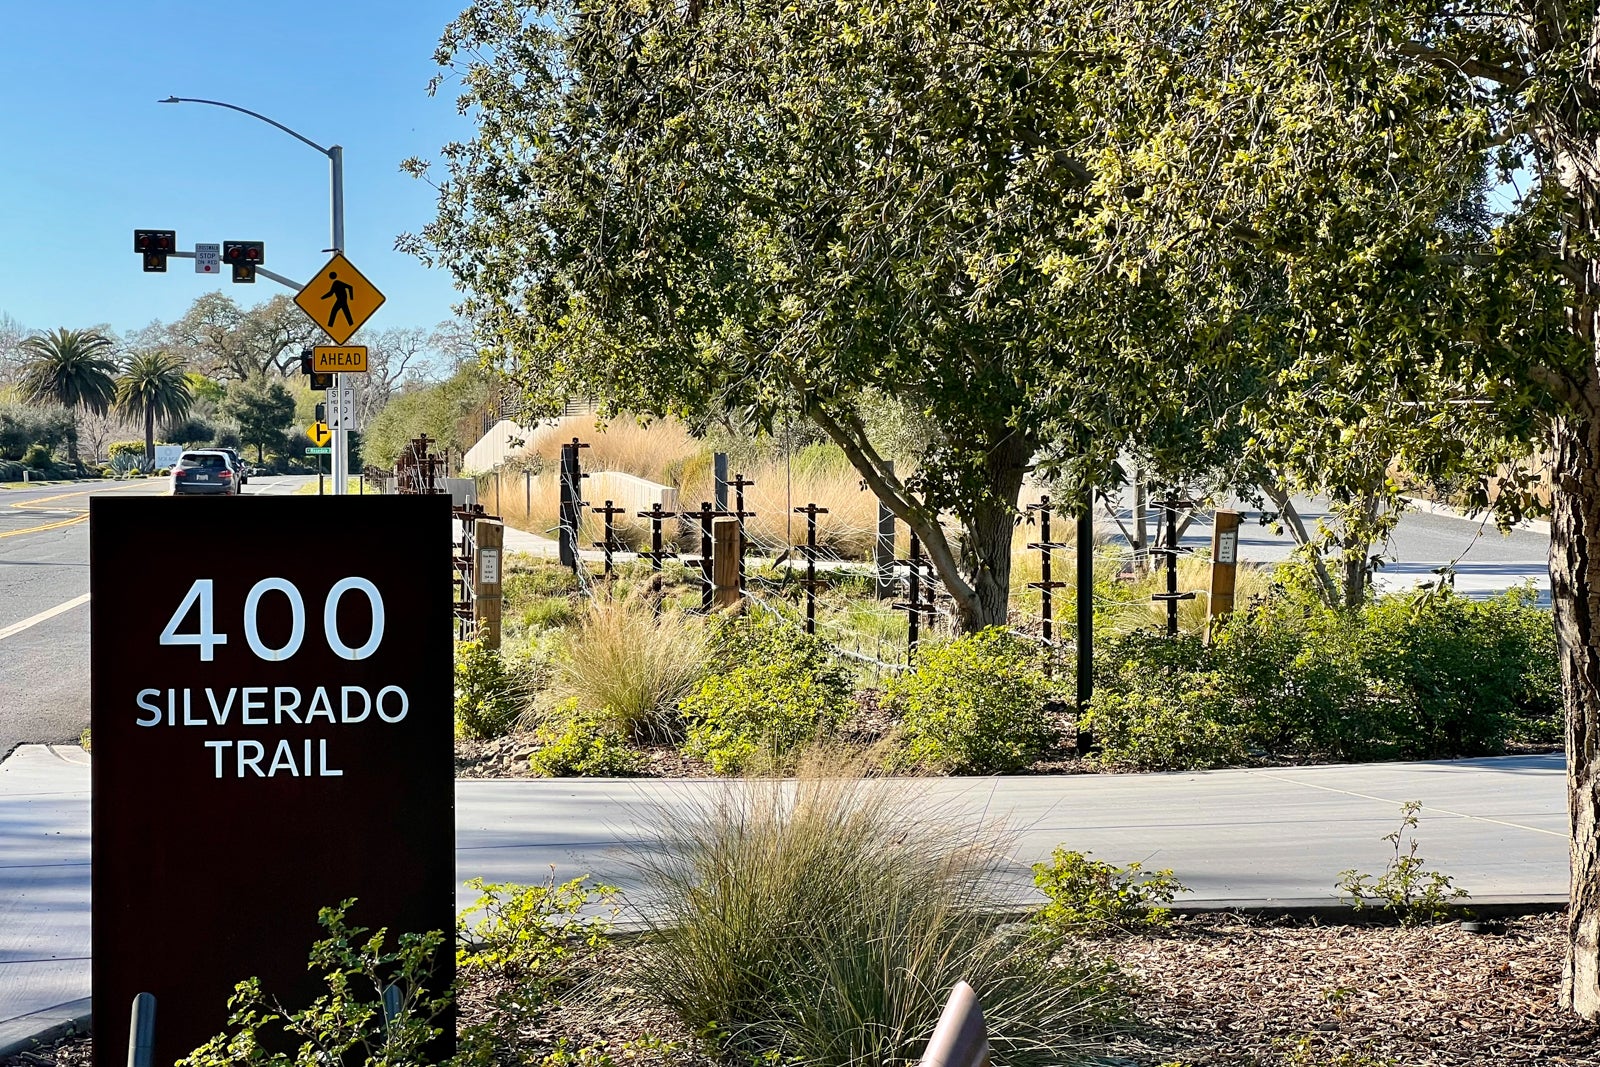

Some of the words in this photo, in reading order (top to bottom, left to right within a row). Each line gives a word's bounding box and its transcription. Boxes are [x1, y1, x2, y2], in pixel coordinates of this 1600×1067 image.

[320, 353, 361, 366] AHEAD
[159, 576, 386, 662] 400
[135, 685, 409, 727] SILVERADO
[204, 738, 344, 779] TRAIL
